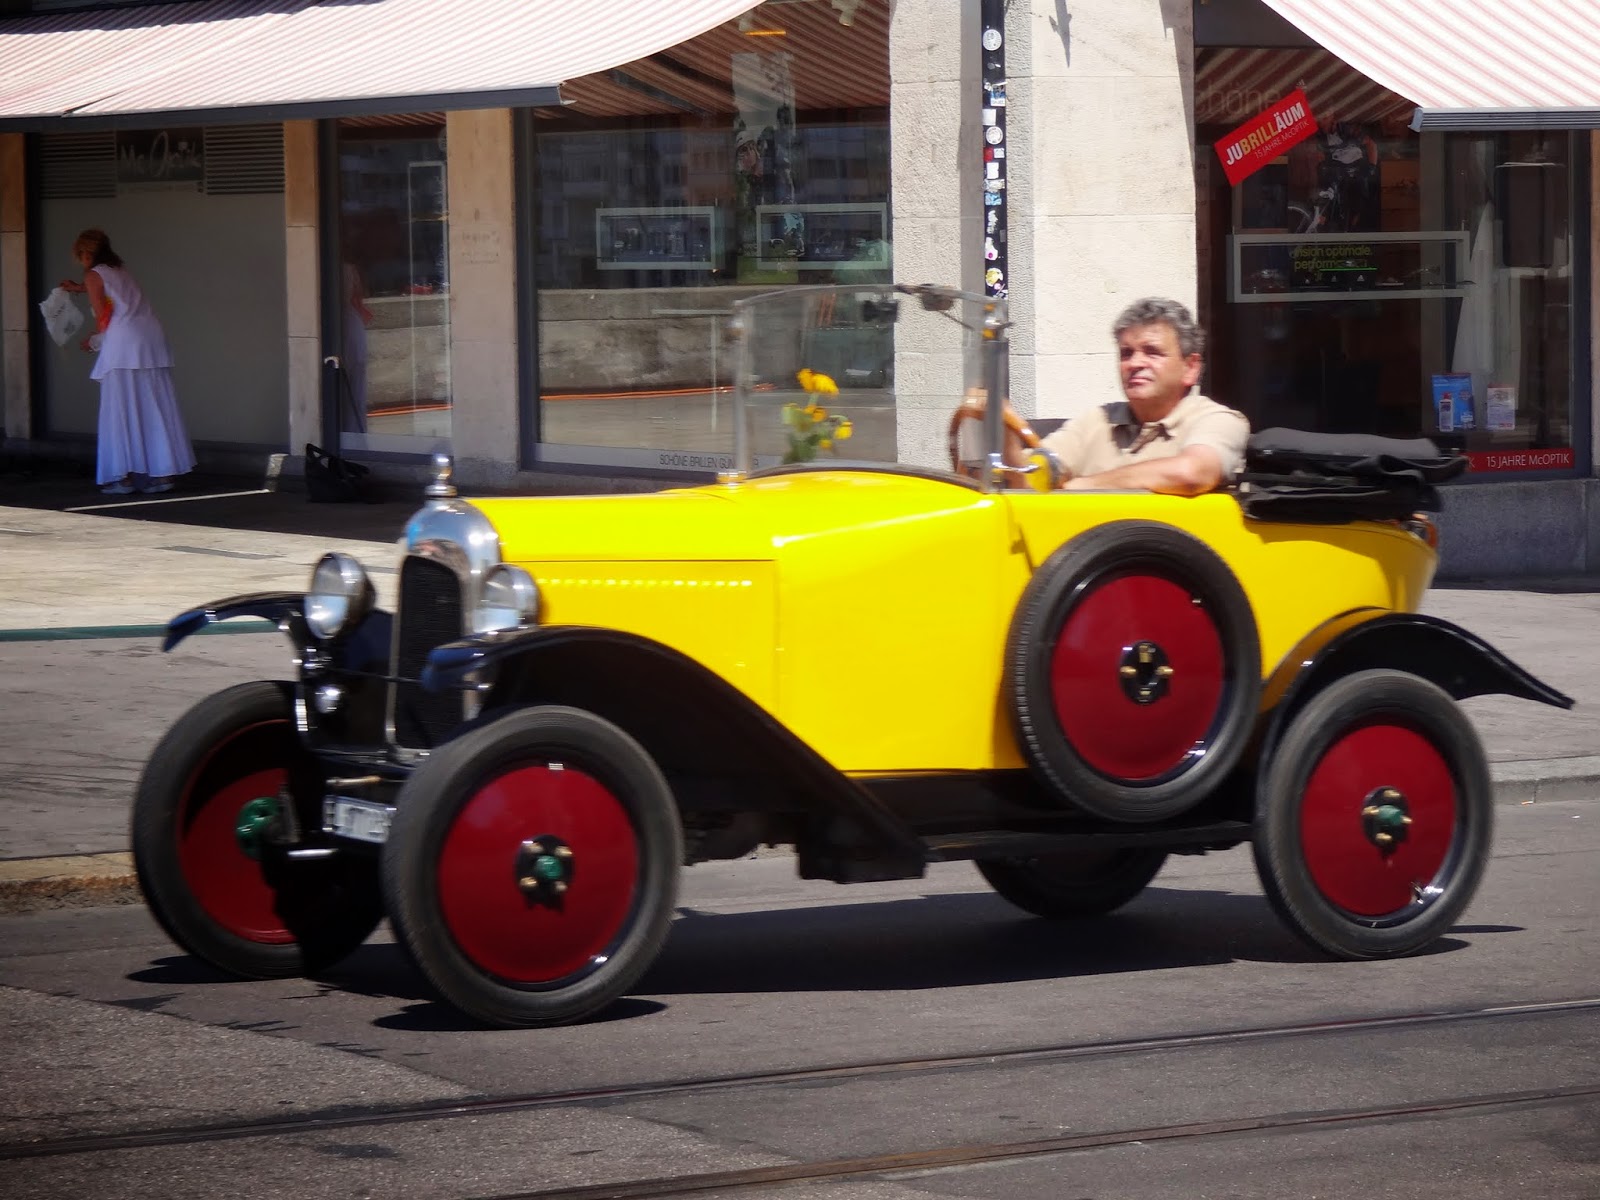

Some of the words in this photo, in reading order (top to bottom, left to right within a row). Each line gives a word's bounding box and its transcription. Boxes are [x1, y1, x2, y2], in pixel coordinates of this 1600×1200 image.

[1226, 102, 1306, 165] JUBRILLÄUM
[1262, 138, 1281, 155] JAHRE
[660, 454, 688, 466] SCHÖNE
[690, 456, 717, 468] BRILLEN
[1486, 456, 1496, 468] 15
[1497, 455, 1526, 468] JAHRE
[1528, 453, 1570, 466] McOPTIK
